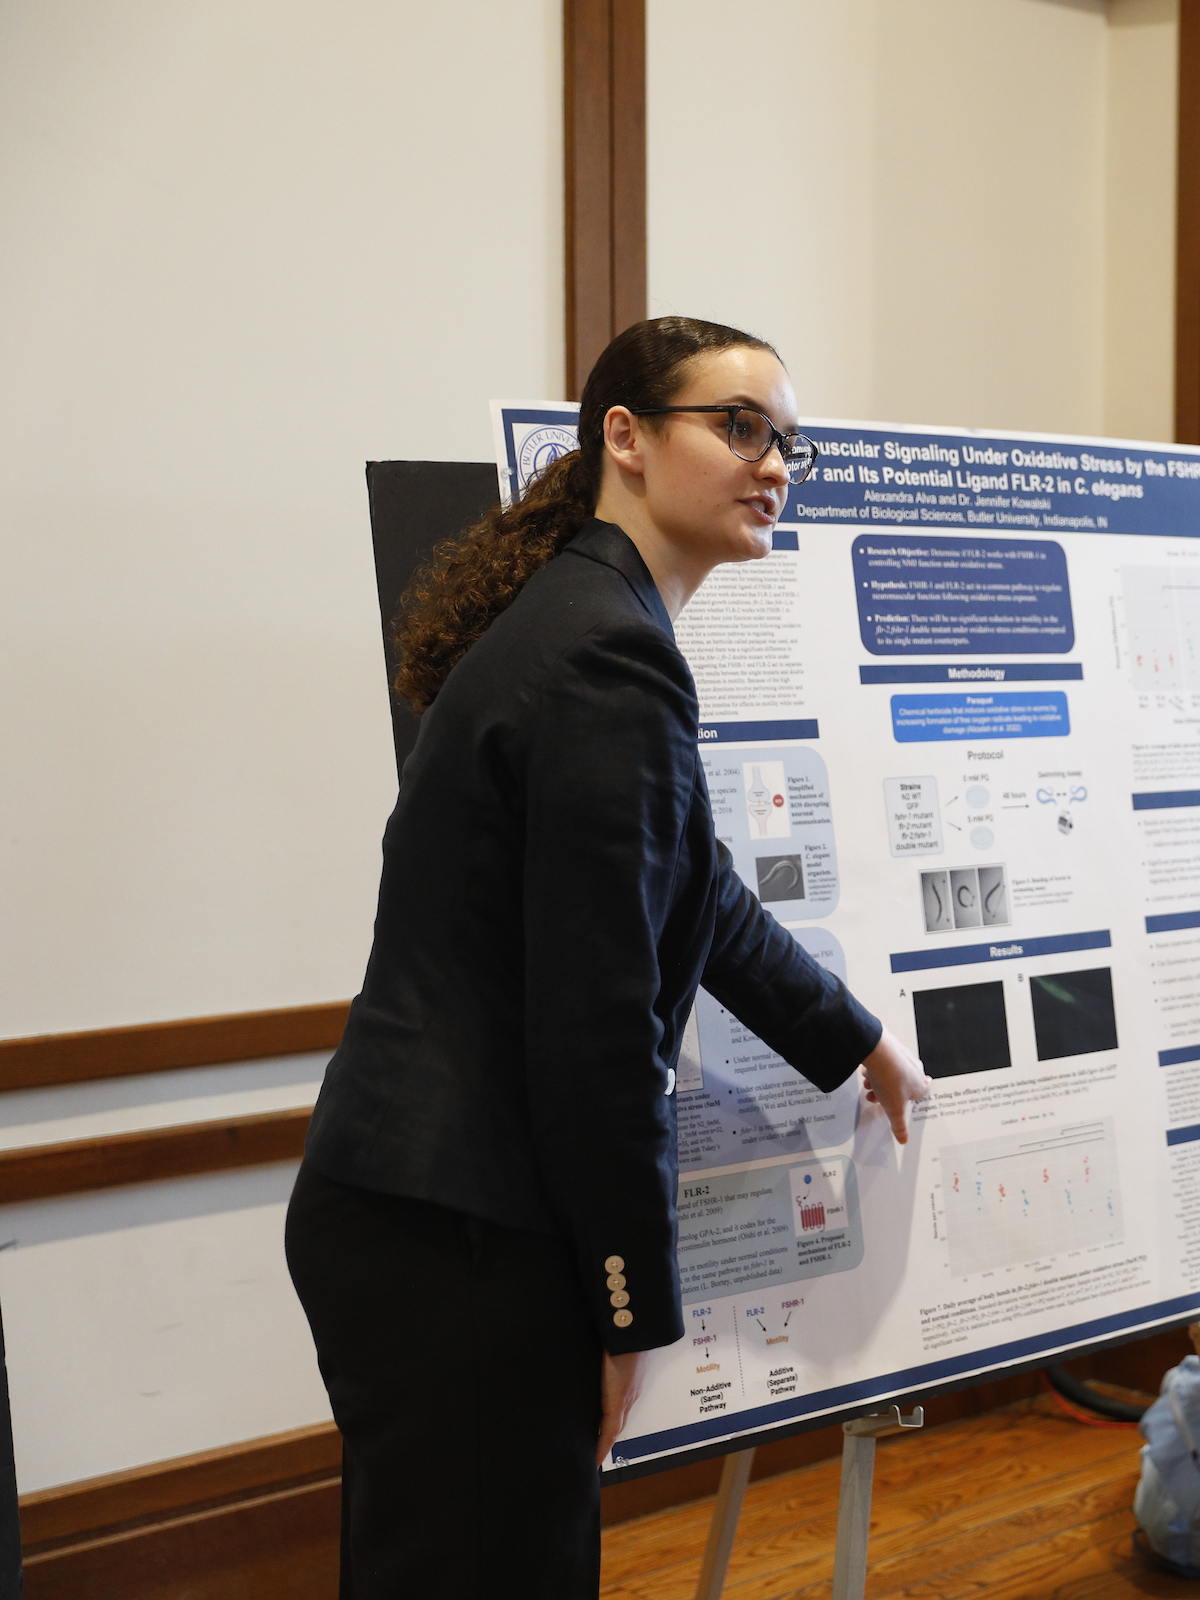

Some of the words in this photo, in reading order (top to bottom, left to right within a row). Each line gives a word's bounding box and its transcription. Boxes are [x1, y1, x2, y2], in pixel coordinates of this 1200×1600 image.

[523, 433, 544, 466] BUTLER
[884, 441, 959, 466] Signaling
[963, 446, 1008, 466] Under
[1011, 449, 1078, 471] Oxidative
[1081, 453, 1124, 474] Stress
[1126, 457, 1143, 479] by
[1145, 459, 1166, 476] the
[823, 466, 855, 483] and
[859, 466, 880, 484] Its
[882, 467, 952, 487] Potential
[957, 470, 1008, 493] Ligand
[1011, 474, 1055, 493] FLR-2
[1057, 476, 1070, 494] in
[1074, 478, 1089, 496] C.
[1092, 480, 1143, 501] elegans
[864, 489, 914, 504] Alexandra
[915, 492, 936, 504] Alva
[938, 493, 956, 505] and
[957, 493, 973, 506] Dr.
[974, 494, 1010, 508] Jennifer
[1012, 497, 1051, 510] Kowalski
[797, 504, 857, 519] Department
[859, 505, 870, 518] of
[872, 507, 919, 522] Biological
[920, 508, 966, 523] Sciences,
[967, 510, 994, 523] Butler
[996, 511, 1042, 528] University,
[1044, 514, 1096, 529] Indianapolis,
[1097, 517, 1108, 528] IN
[867, 547, 896, 556] Research
[868, 559, 901, 569] controlling
[918, 560, 942, 568] function
[871, 580, 908, 590] Hypothesis:
[872, 592, 916, 601] neuromuscular
[917, 592, 941, 601] function
[942, 593, 969, 603] following
[875, 614, 910, 623] Prediction:
[910, 625, 931, 634] double
[948, 668, 1005, 681] Methodology
[966, 697, 994, 706] Paraquat
[899, 708, 925, 716] Chemical
[897, 718, 926, 727] increasing
[927, 717, 952, 725] formation
[968, 750, 1004, 761] Protocol
[788, 776, 804, 784] Figure
[1038, 771, 1065, 779] Swimming
[717, 787, 737, 796] species
[789, 784, 814, 792] Simplified
[900, 783, 921, 791] Strains
[911, 792, 921, 800] WT
[1010, 791, 1026, 799] hours
[906, 802, 919, 810] GFP
[913, 811, 934, 819] mutant
[911, 821, 932, 829] mutant
[896, 841, 916, 850] double
[917, 841, 938, 849] mutant
[821, 950, 834, 958] FSH
[989, 944, 1023, 958] Results
[1018, 973, 1024, 982] B
[900, 989, 906, 998] A
[730, 1026, 742, 1034] role
[733, 1055, 750, 1064] Under
[752, 1052, 772, 1062] normal
[734, 1063, 757, 1074] required
[759, 1062, 767, 1070] for
[736, 1084, 754, 1094] Under
[755, 1081, 780, 1092] oxidative
[782, 1079, 797, 1088] stress
[758, 1091, 784, 1102] displayed
[785, 1087, 804, 1098] further
[934, 1091, 953, 1100] Testing
[738, 1104, 760, 1115] motility
[761, 1101, 777, 1113] (Wei
[777, 1100, 787, 1109] and
[788, 1096, 814, 1107] Kowalski
[765, 1120, 787, 1131] required
[813, 1113, 836, 1123] function
[741, 1135, 758, 1145] under
[759, 1131, 786, 1142] oxidative
[684, 1185, 710, 1199] FLR-2
[692, 1201, 699, 1209] of
[699, 1196, 724, 1207] FSHR-1
[724, 1194, 736, 1203] that
[736, 1192, 749, 1202] may
[750, 1187, 773, 1199] regulate
[706, 1206, 723, 1218] 2009)
[827, 1206, 844, 1214] FSHR-1
[699, 1227, 722, 1239] GPA-2,
[723, 1225, 733, 1234] and
[740, 1220, 756, 1231] codes
[757, 1219, 766, 1228] for
[767, 1217, 776, 1226] the
[712, 1236, 738, 1248] hormone
[738, 1232, 756, 1244] (Oishi
[772, 1224, 789, 1236] 2009)
[797, 1239, 814, 1249] Figure
[821, 1233, 845, 1244] Proposed
[798, 1246, 827, 1257] mechanism
[834, 1240, 851, 1250] FLR-2
[697, 1260, 719, 1270] motility
[720, 1257, 737, 1265] under
[738, 1252, 758, 1262] normal
[759, 1246, 788, 1258] conditions
[799, 1257, 809, 1266] and
[691, 1274, 701, 1282] the
[702, 1272, 717, 1280] same
[718, 1266, 741, 1277] pathway
[733, 1270, 767, 1284] unpublished
[768, 1266, 783, 1277] data)
[781, 1298, 805, 1309] FSHR-1
[693, 1307, 712, 1318] FLR-2
[746, 1307, 765, 1317] FLR-2
[920, 1307, 937, 1316] Figure
[693, 1334, 717, 1346] FSHR-1
[766, 1335, 789, 1346] Motility
[696, 1363, 720, 1374] Motility
[769, 1366, 794, 1377] Additive
[767, 1374, 798, 1389] (Separate)
[690, 1381, 732, 1396] Non-Additive
[771, 1384, 796, 1396] Pathway
[701, 1392, 723, 1405] (Same)
[699, 1402, 726, 1414] Pathway
